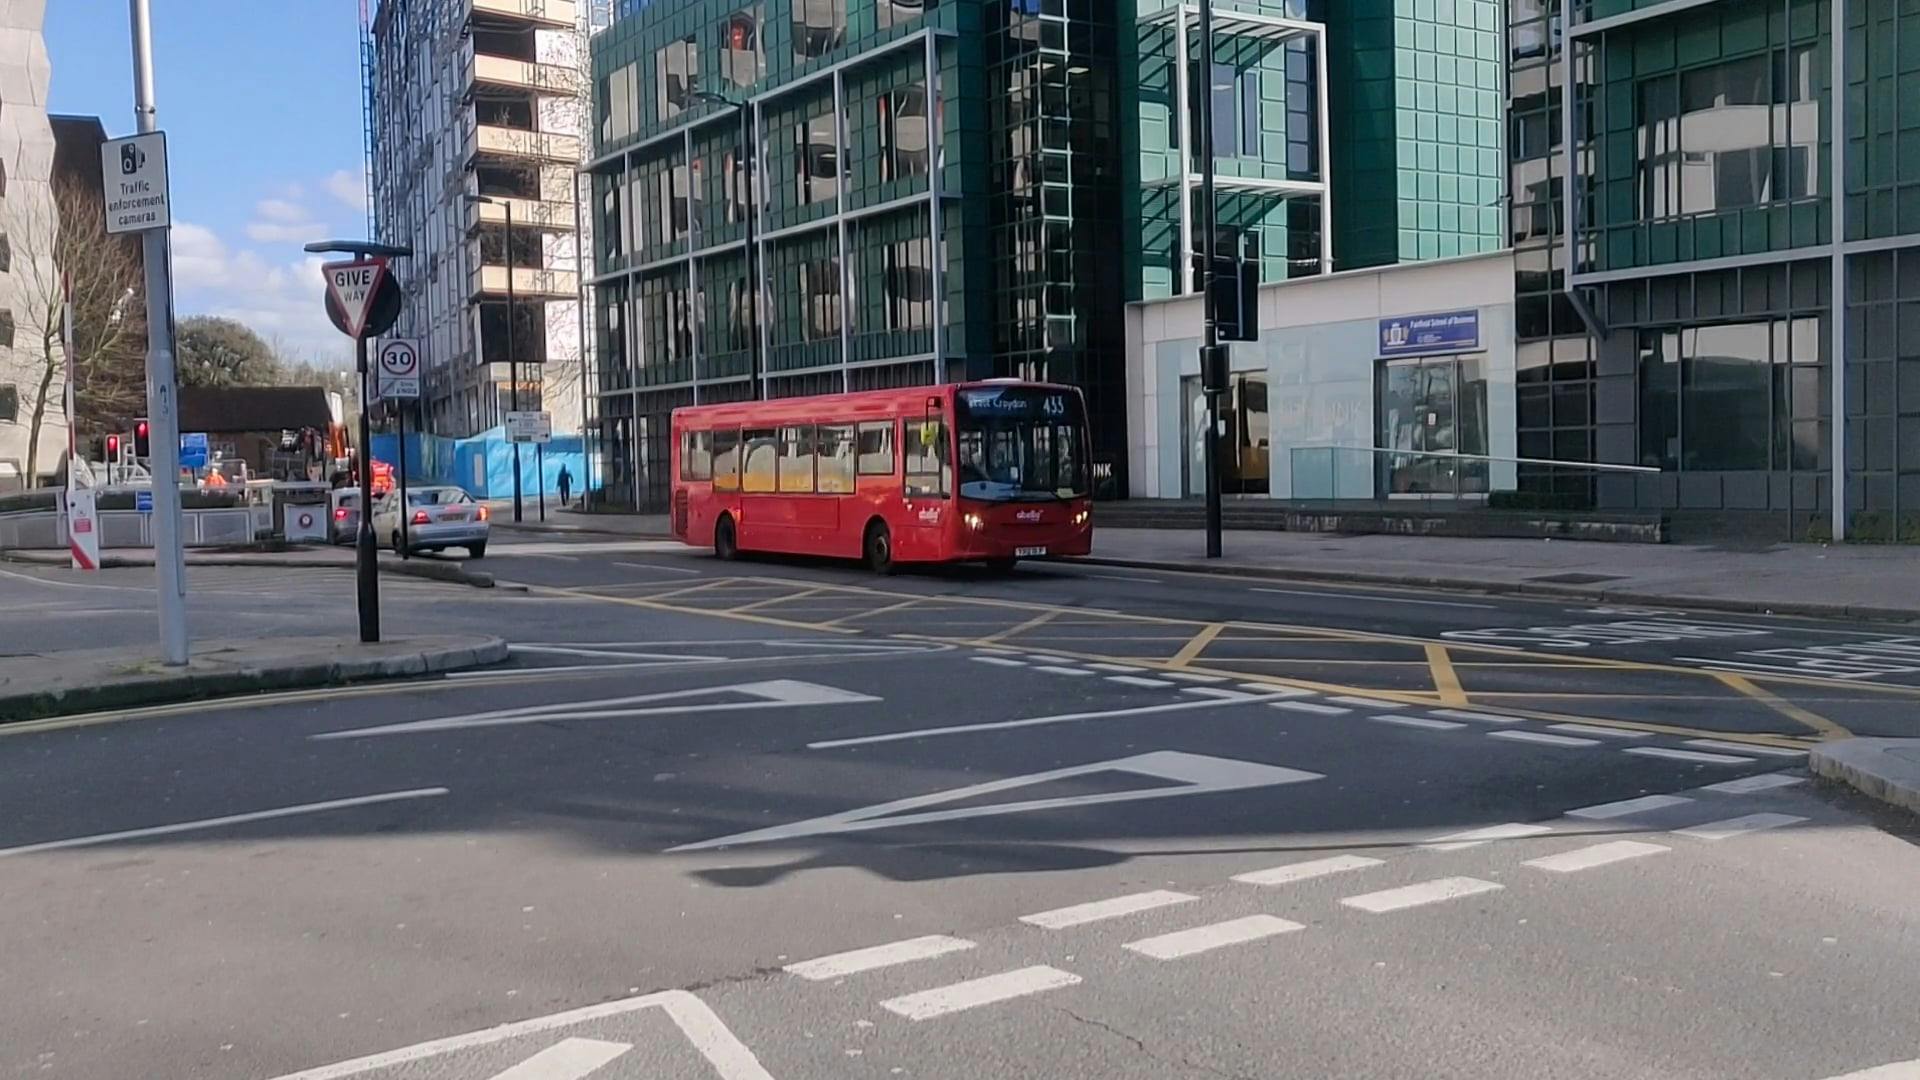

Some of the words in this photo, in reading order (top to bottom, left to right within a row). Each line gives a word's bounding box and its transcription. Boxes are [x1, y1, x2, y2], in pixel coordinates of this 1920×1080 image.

[120, 180, 150, 195] Traffic
[109, 193, 165, 212] enforcement
[118, 212, 156, 225] cameras
[335, 270, 370, 287] GIVE
[344, 290, 365, 302] WAY
[387, 351, 411, 365] 30
[993, 399, 1028, 411] Croydon
[1093, 463, 1112, 479] INK
